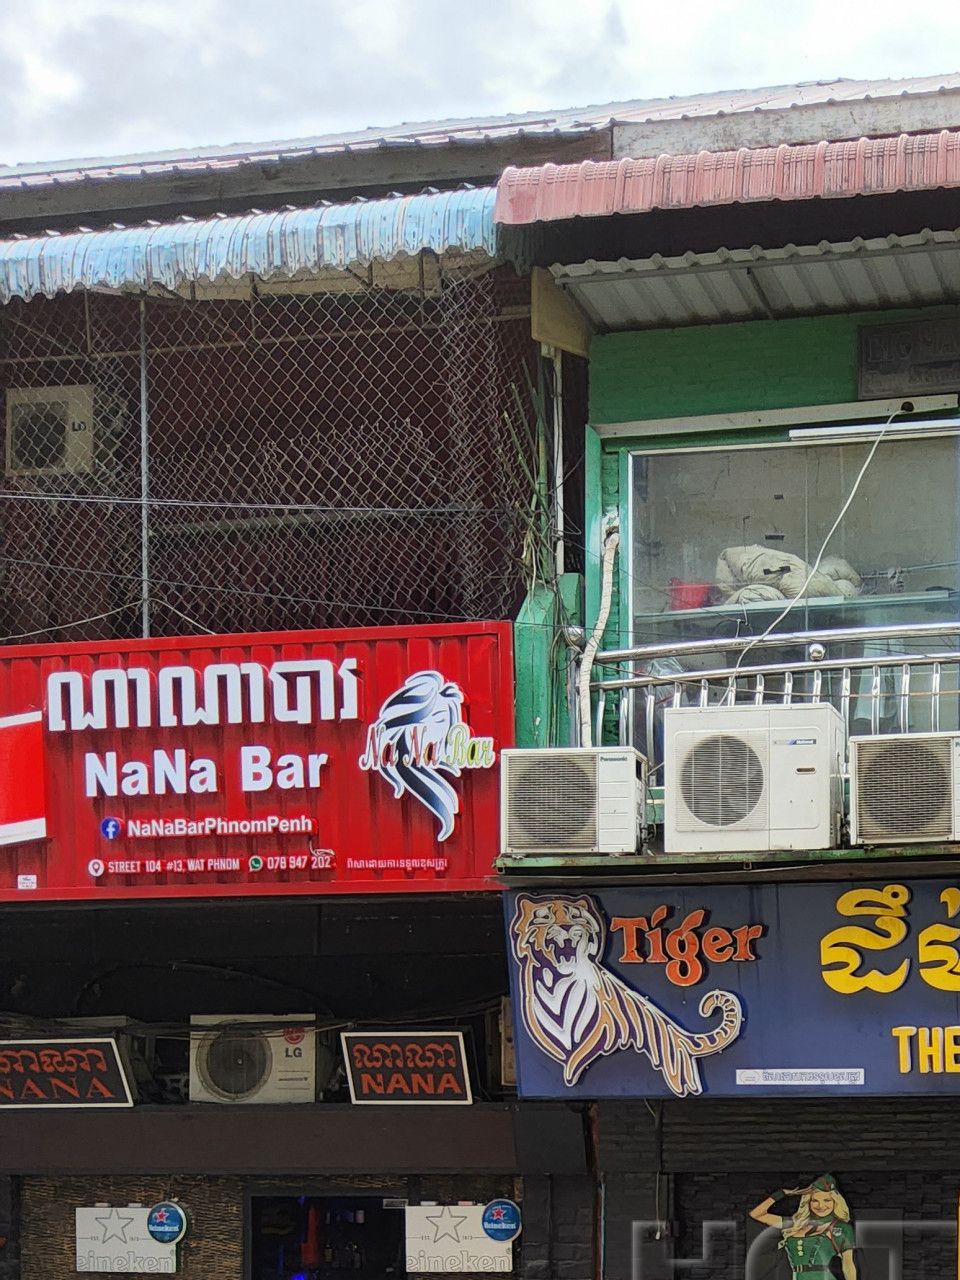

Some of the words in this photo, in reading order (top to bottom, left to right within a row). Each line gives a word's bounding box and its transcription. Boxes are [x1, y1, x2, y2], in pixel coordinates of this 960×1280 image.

[47, 657, 359, 732] ណាណាបារ
[85, 749, 218, 798] NaNa
[241, 745, 328, 792] Bar
[128, 815, 312, 838] NaNaBarPhnomPenh
[108, 860, 141, 873] STREET
[145, 859, 161, 872] 104
[187, 859, 205, 872] WAT
[207, 858, 240, 871] PHNOM
[267, 856, 287, 870] 078
[289, 856, 307, 869] 947
[311, 855, 331, 869] 202
[611, 905, 762, 987] Tiger
[285, 1047, 303, 1058] LG
[360, 1073, 462, 1095] NANA
